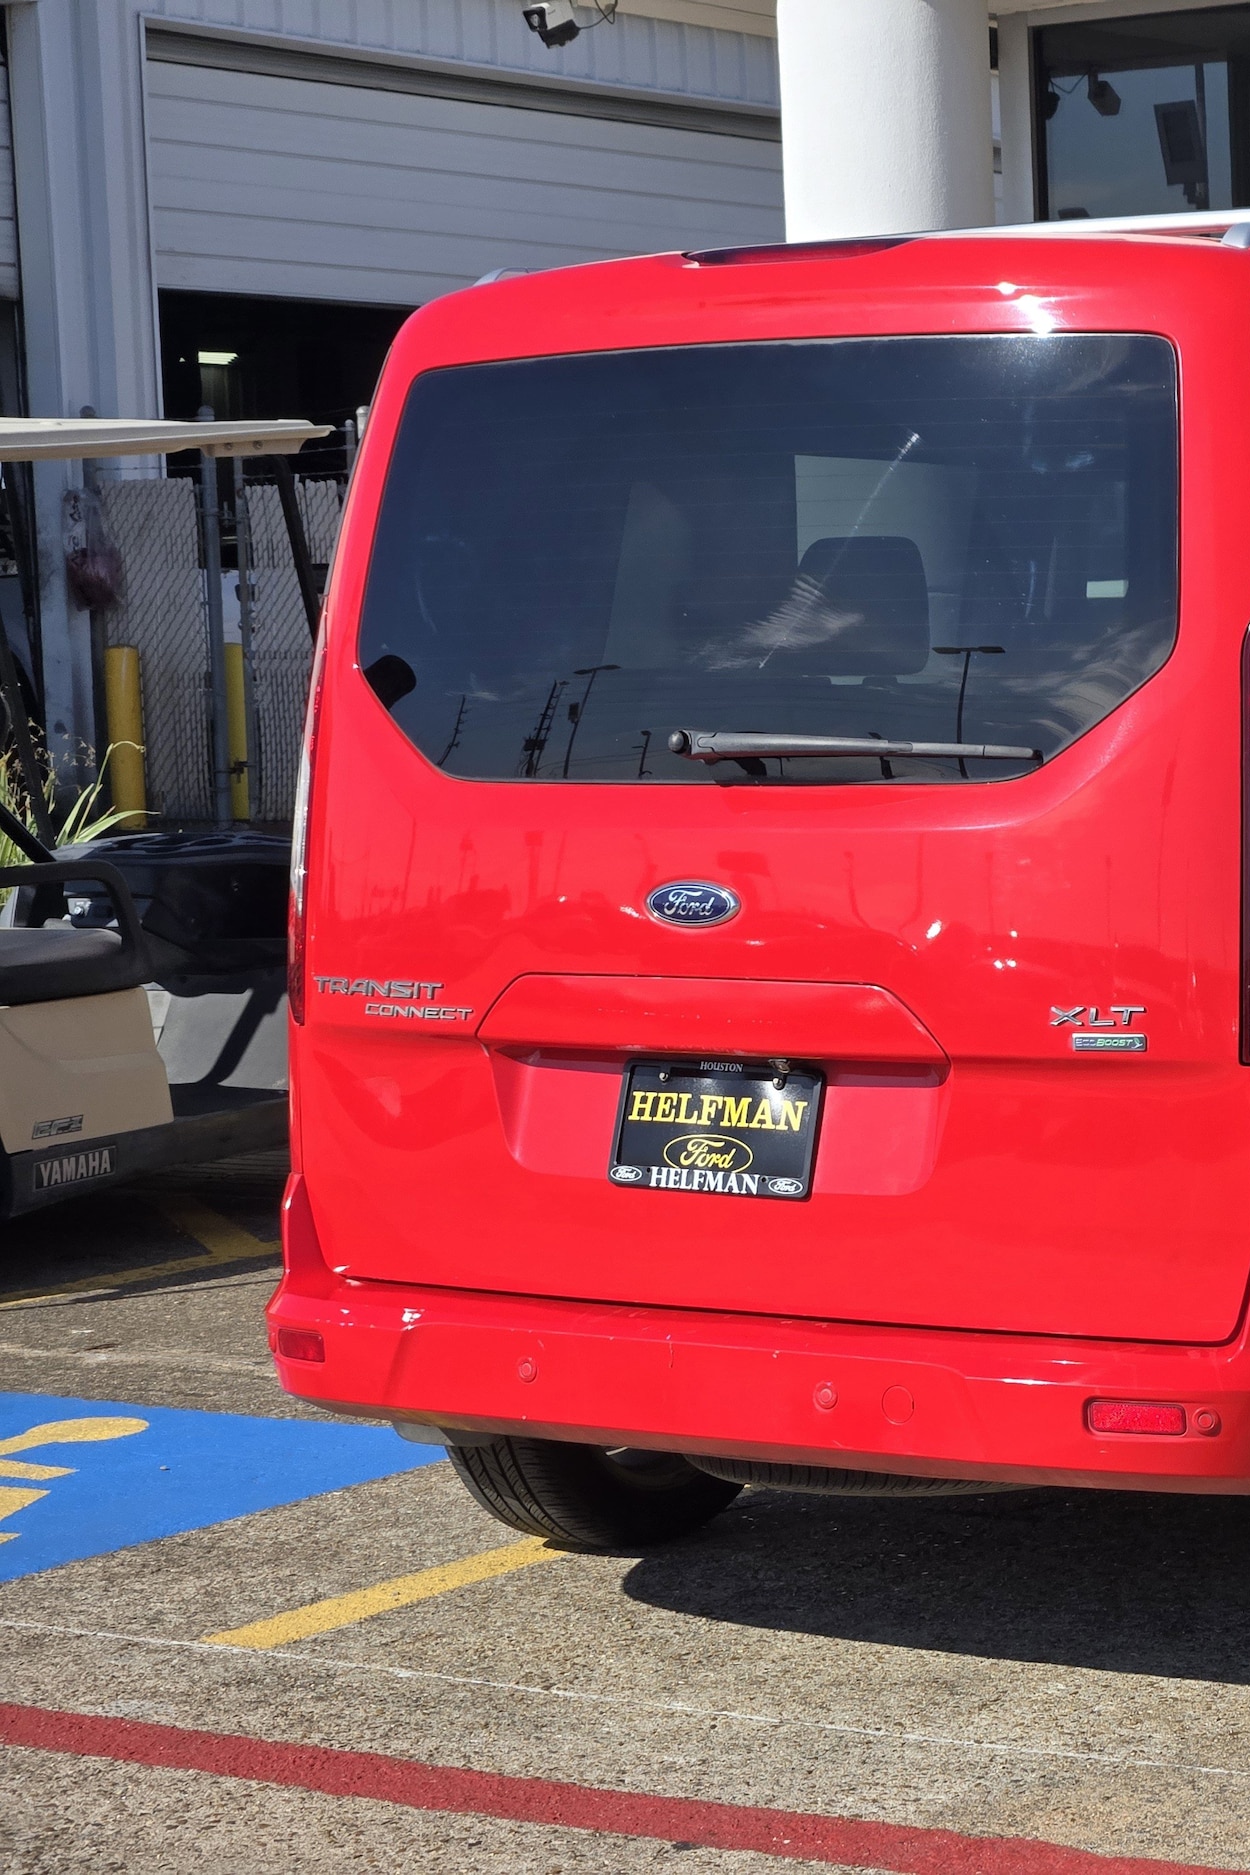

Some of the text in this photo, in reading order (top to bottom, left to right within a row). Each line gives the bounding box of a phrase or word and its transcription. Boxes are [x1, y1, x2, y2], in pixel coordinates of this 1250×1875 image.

[663, 889, 715, 915] Ford
[314, 976, 443, 999] TRANSIT
[365, 1003, 473, 1020] CONNECT
[1051, 1006, 1145, 1026] XLT
[700, 1061, 743, 1073] HOUSTON
[628, 1091, 807, 1131] HELFMAN
[680, 1138, 736, 1169] Ford
[40, 1150, 111, 1187] YAMAHA
[649, 1166, 760, 1195] HELFMAN
